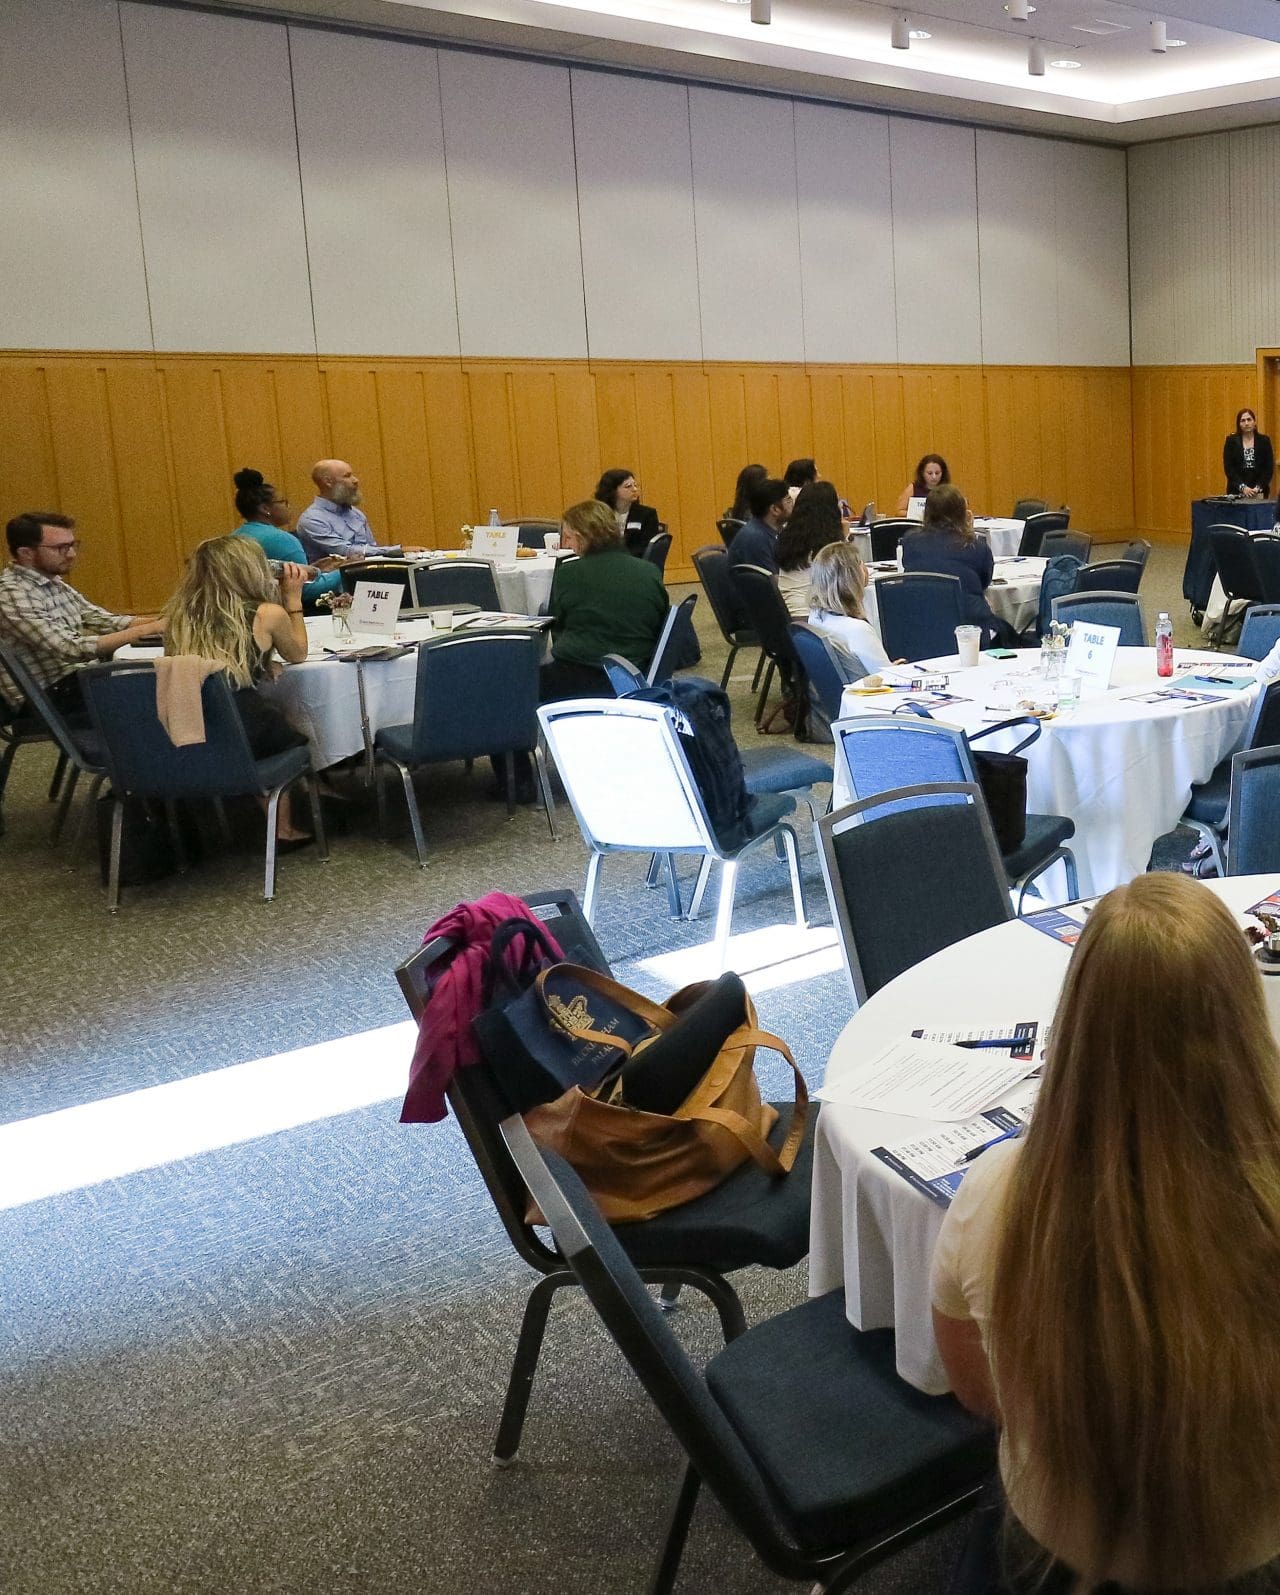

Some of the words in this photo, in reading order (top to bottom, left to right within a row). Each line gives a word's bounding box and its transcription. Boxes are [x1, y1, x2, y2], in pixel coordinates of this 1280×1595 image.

[486, 531, 506, 539] TABLE
[367, 590, 389, 600] TABLE
[372, 604, 377, 612] 5
[1083, 633, 1105, 646] TABLE
[1088, 650, 1093, 660] 6
